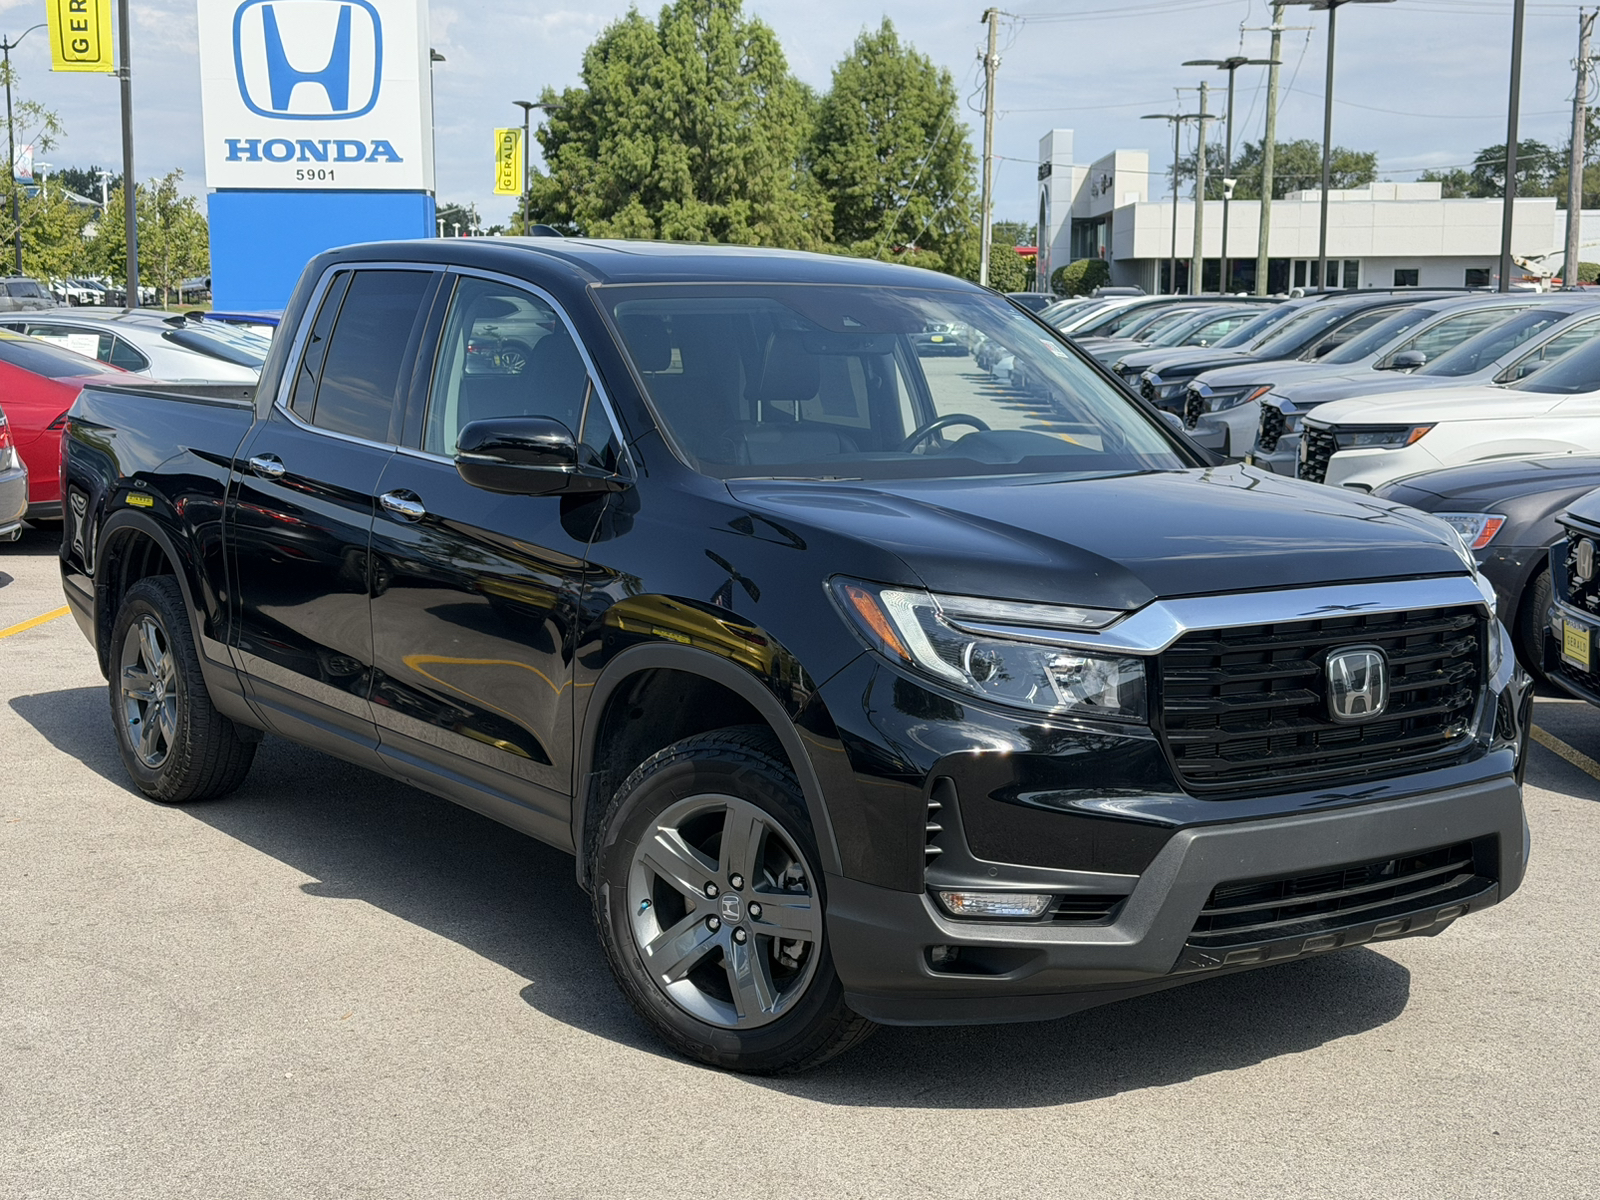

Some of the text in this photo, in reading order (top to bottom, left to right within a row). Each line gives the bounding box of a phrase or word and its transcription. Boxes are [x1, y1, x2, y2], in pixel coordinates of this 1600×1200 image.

[224, 138, 404, 163] HONDA
[503, 135, 513, 187] GERALD
[296, 168, 335, 181] 5901
